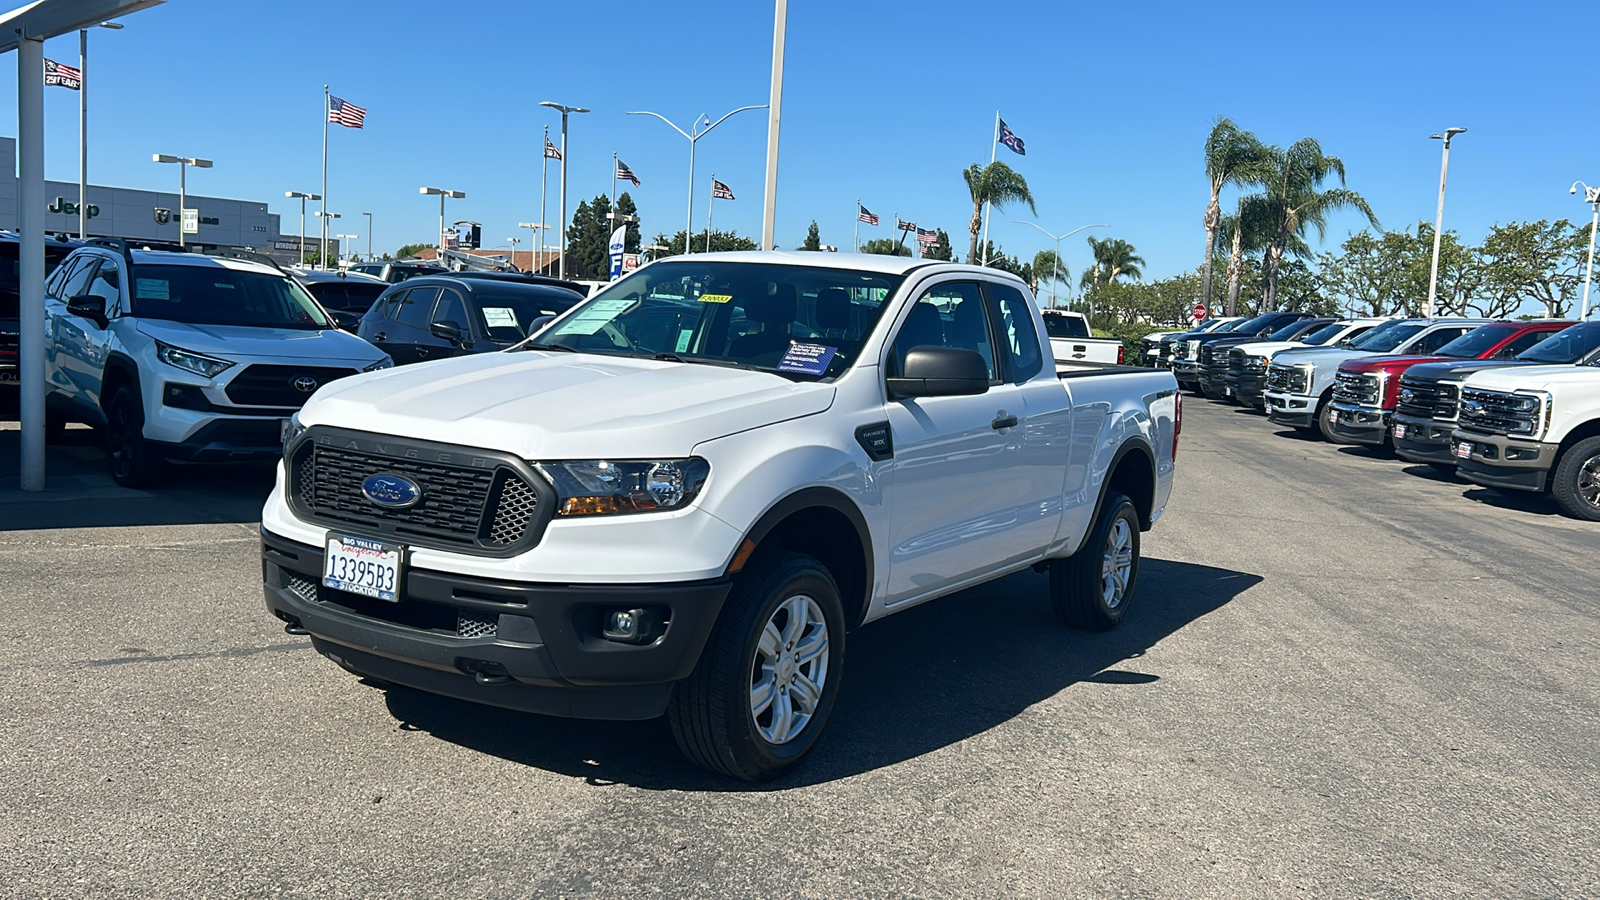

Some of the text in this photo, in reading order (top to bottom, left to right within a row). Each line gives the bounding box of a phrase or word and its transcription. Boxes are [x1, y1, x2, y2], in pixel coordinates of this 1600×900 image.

[275, 242, 297, 250] WINDOW
[863, 429, 886, 438] RANGER
[873, 438, 886, 446] STX
[320, 435, 486, 468] RANGER
[370, 479, 403, 500] Ford
[356, 540, 382, 551] VALLEY
[328, 554, 395, 591] 13395B3
[339, 581, 380, 598] STOCKTON
